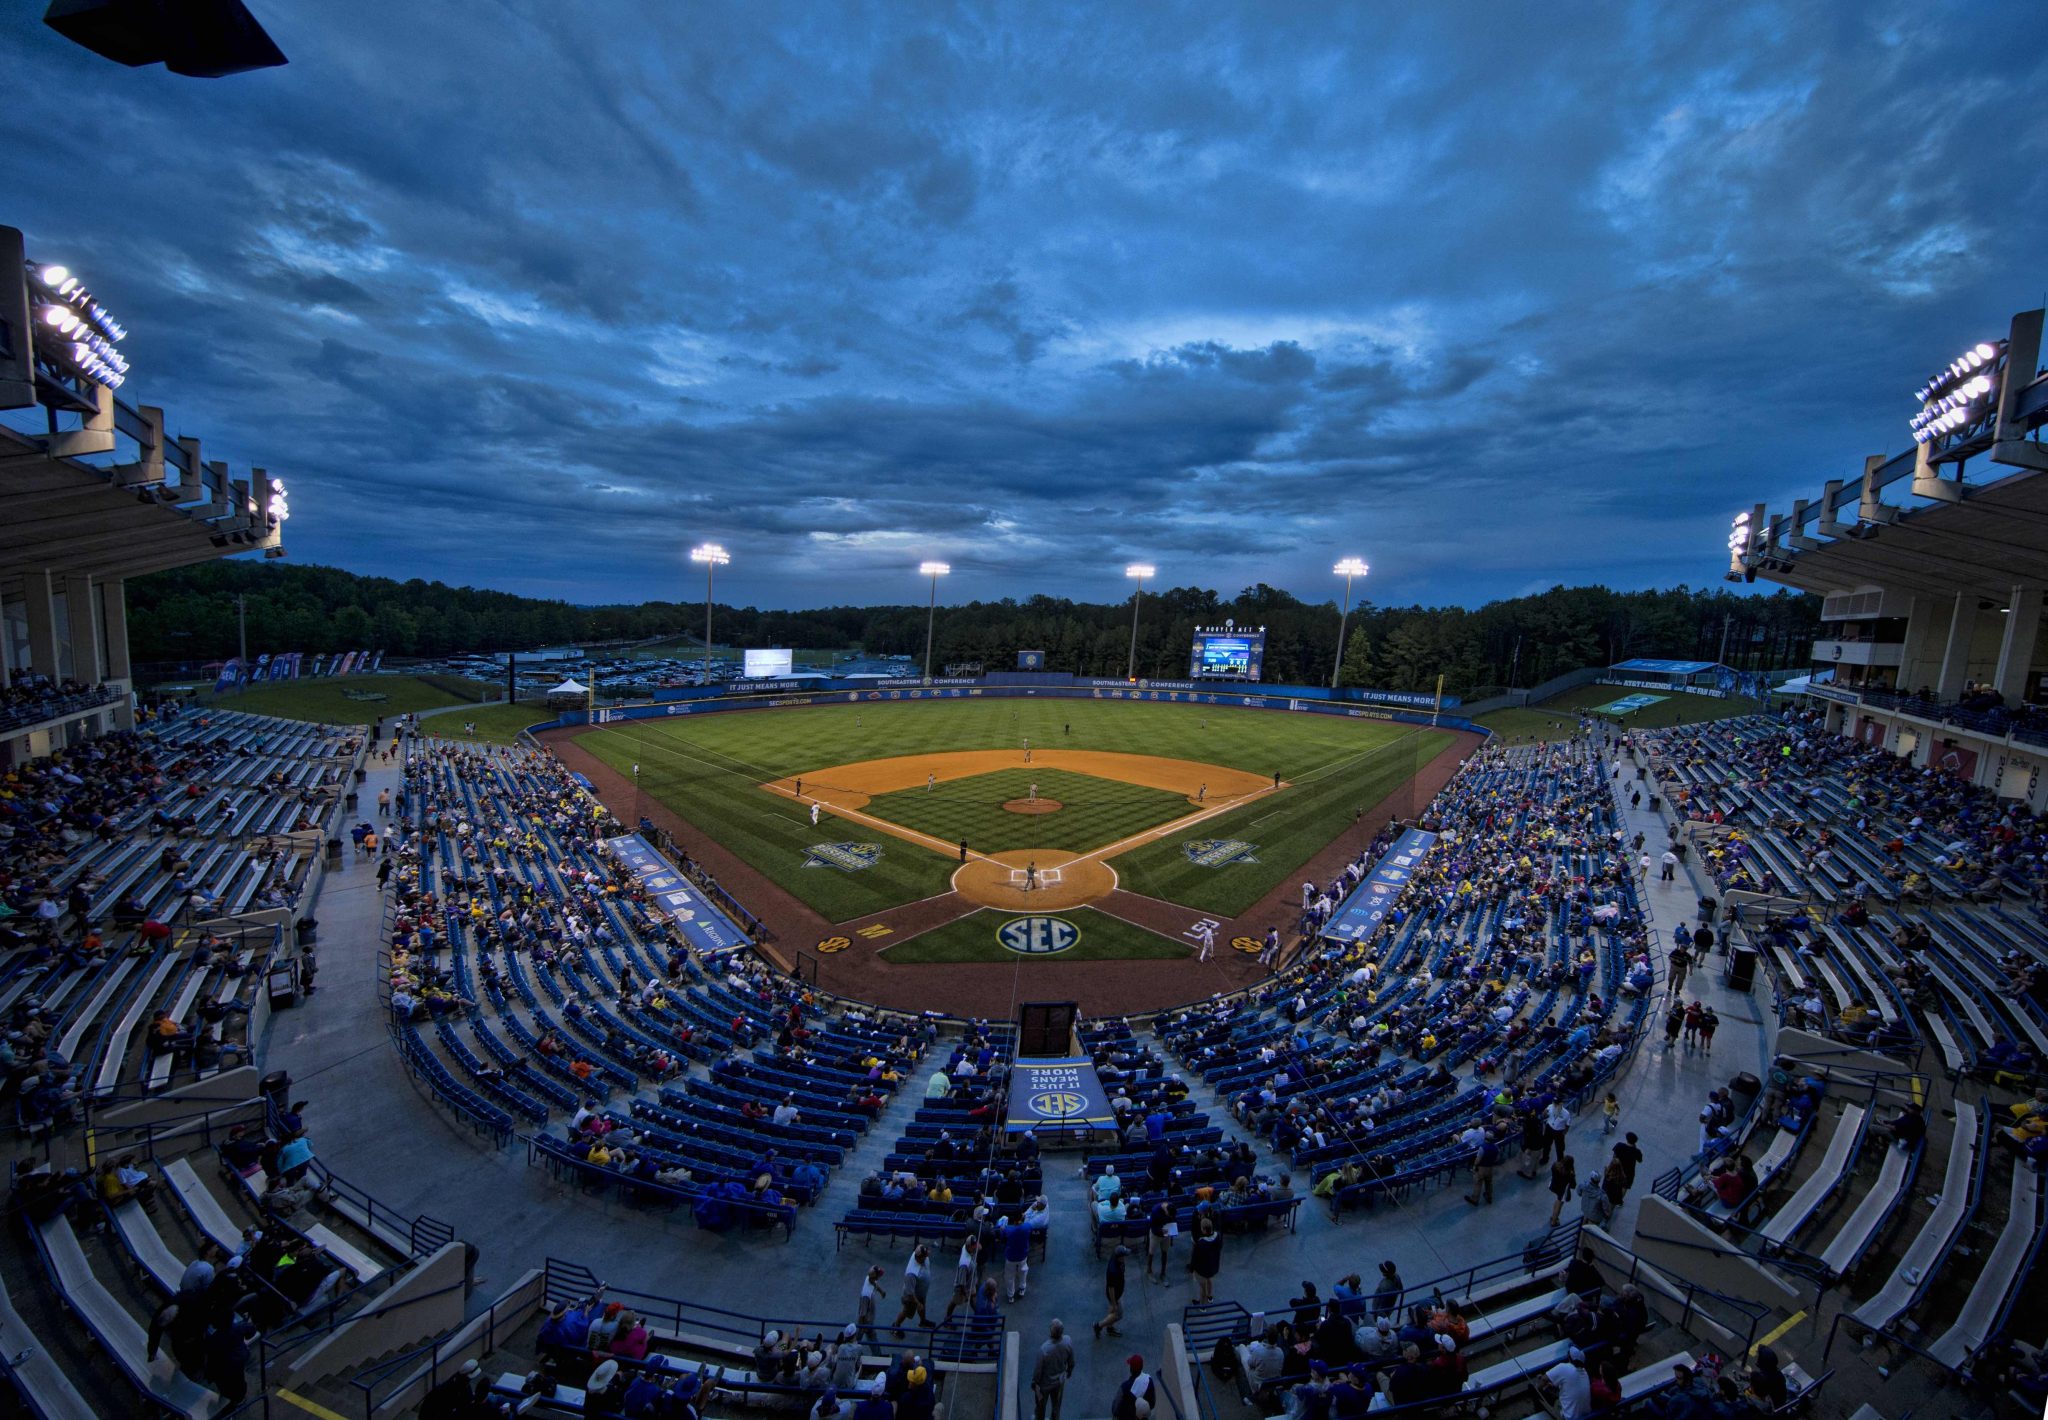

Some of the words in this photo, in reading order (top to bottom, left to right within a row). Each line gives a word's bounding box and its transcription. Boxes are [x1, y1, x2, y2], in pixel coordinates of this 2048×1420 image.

[755, 682, 778, 690] MEANS
[769, 698, 812, 706] SECSPORTS.COM
[1370, 692, 1387, 700] JUST
[1387, 694, 1412, 703] MEANS
[1348, 709, 1393, 719] SECSPORTS.COM
[703, 926, 727, 947] REGIONS
[1004, 918, 1073, 952] SEC
[1026, 1068, 1078, 1076] MORE.
[1031, 1075, 1079, 1083] MEANS
[1036, 1093, 1080, 1115] SEC
